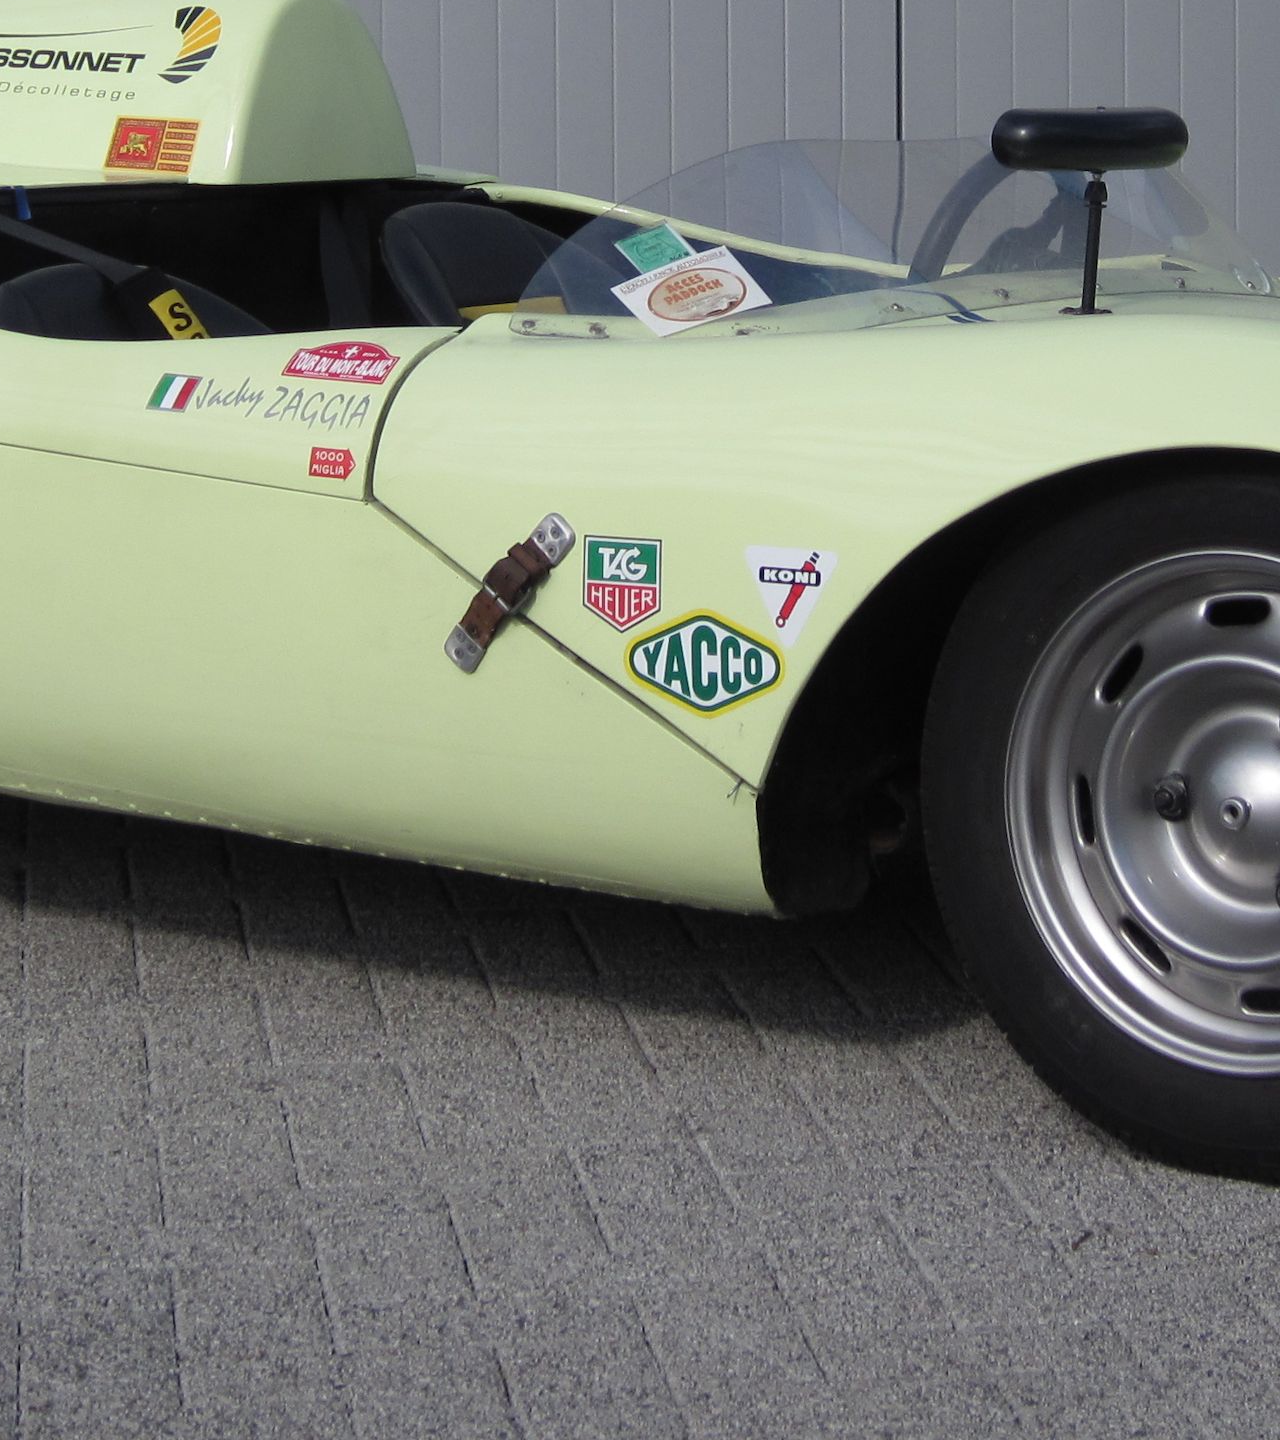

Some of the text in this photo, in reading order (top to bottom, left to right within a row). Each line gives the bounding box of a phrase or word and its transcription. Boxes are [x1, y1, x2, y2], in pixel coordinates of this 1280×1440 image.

[663, 279, 724, 305] PADDOCK
[290, 351, 394, 378] TOUR DU MONT-BLANC
[195, 376, 371, 432] Jacky ZAGGIA
[311, 463, 345, 476] MIGLIA
[315, 450, 345, 462] 1000
[598, 546, 649, 581] TAG
[763, 568, 817, 585] KONI
[590, 585, 654, 623] HEUER
[641, 624, 764, 701] YACCO
